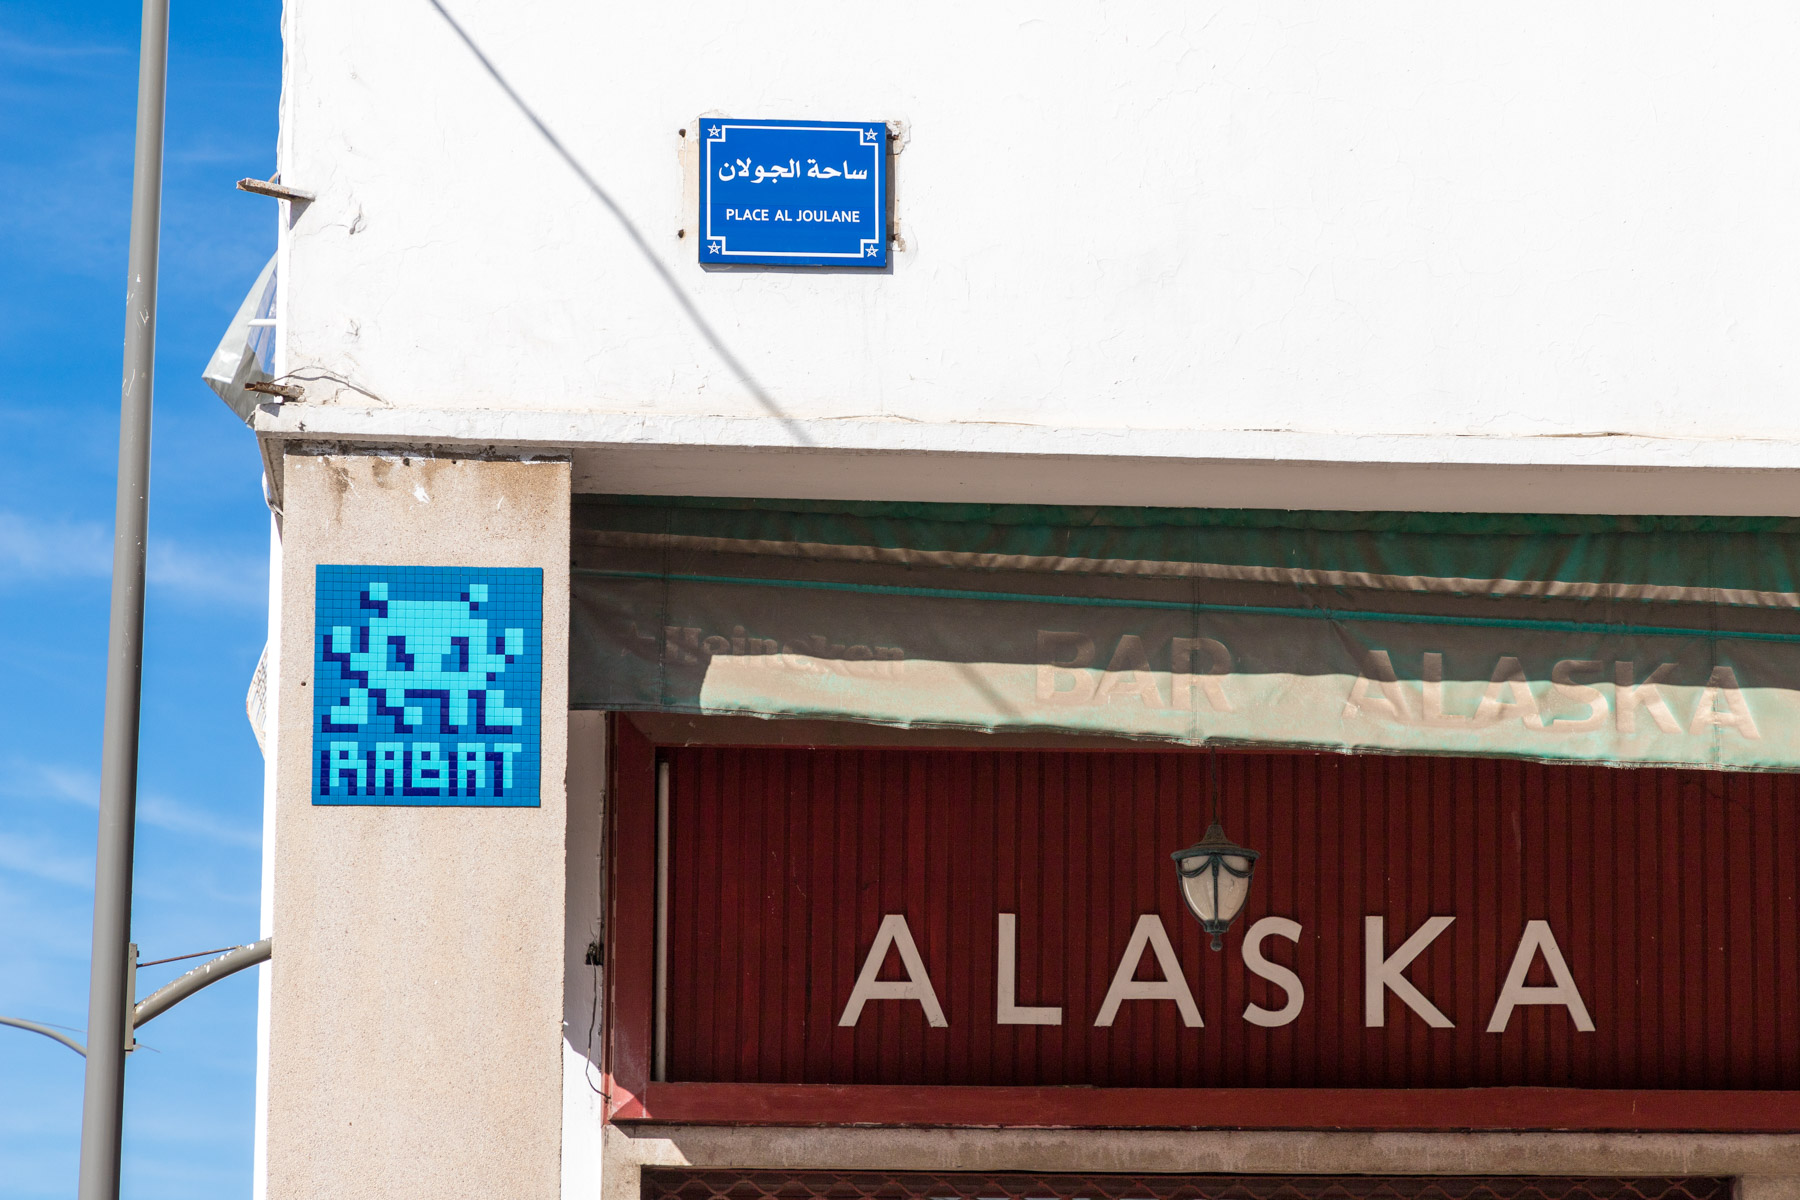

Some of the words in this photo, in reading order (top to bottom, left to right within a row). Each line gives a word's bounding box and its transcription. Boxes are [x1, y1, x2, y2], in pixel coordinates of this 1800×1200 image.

[718, 157, 800, 183] الجولان
[807, 158, 868, 180] ساحة
[726, 208, 769, 222] PLACE
[774, 209, 793, 222] AL
[796, 210, 860, 224] JOULANE
[1034, 629, 1236, 713] BAR
[1341, 648, 1761, 740] ALASKA
[329, 741, 522, 788] RABAT
[838, 913, 1596, 1033] ALASKA
